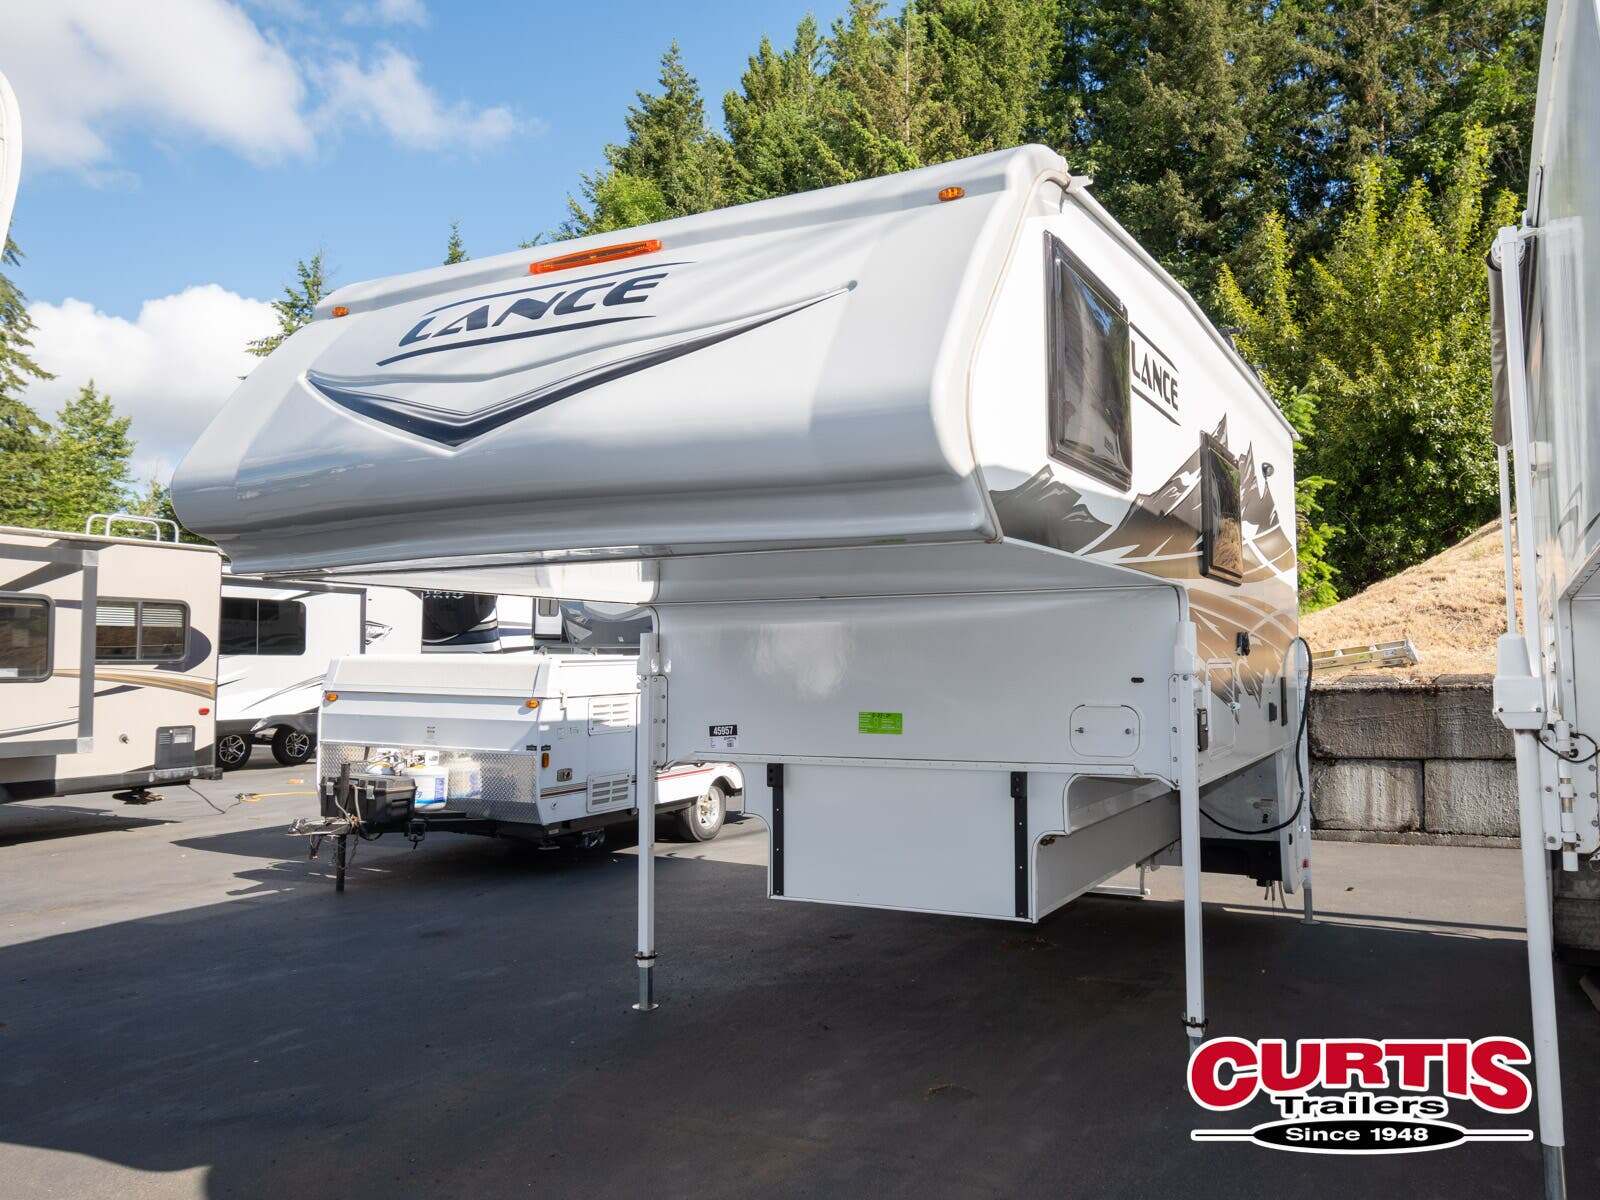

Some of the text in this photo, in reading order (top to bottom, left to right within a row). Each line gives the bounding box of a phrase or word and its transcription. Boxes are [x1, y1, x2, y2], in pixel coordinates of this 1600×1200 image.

[399, 272, 669, 347] LANCE
[1130, 339, 1179, 412] LANCE
[713, 725, 734, 736] 45957
